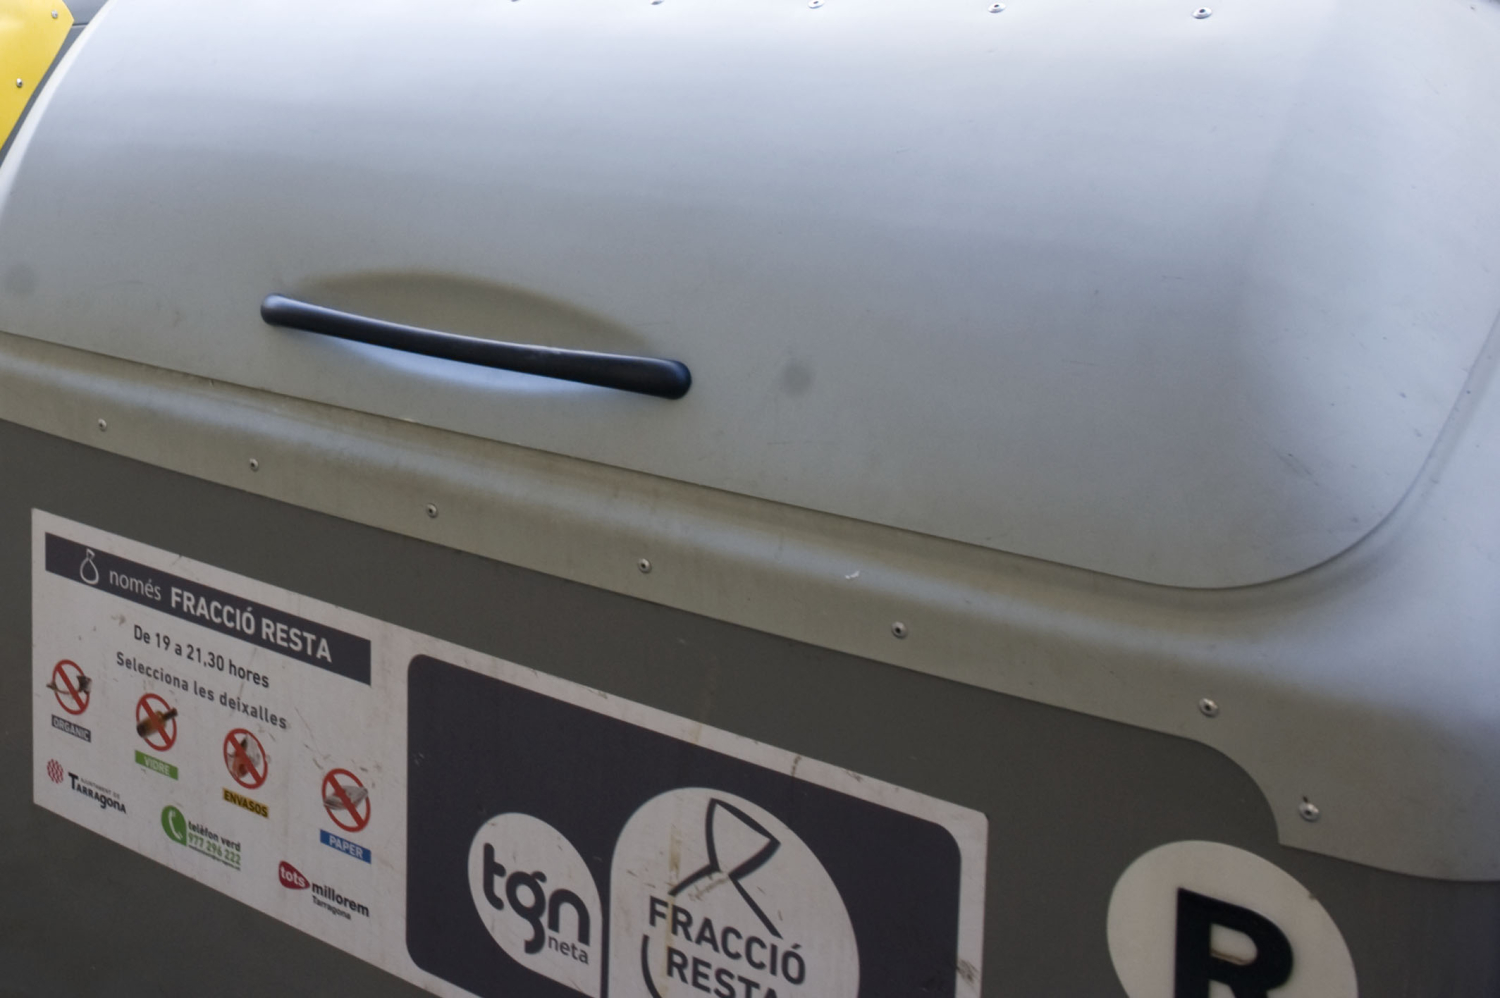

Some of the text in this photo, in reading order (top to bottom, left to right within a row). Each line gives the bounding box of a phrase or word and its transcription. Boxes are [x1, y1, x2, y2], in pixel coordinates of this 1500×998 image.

[109, 570, 333, 663] només FRACCIÓ RESTA
[133, 624, 151, 644] De
[155, 633, 171, 651] 19
[228, 660, 270, 688] hores
[116, 652, 288, 729] Selecciona les deixalles
[143, 755, 171, 776] VIDRE
[224, 790, 269, 818] ENVASOS
[188, 820, 241, 852] telèfon verd
[188, 832, 204, 848] 977
[224, 849, 241, 867] 222
[329, 835, 364, 860] PAPER
[280, 865, 307, 888] tots
[312, 882, 370, 918] millorem
[483, 842, 591, 954] tgn
[548, 935, 589, 965] neta
[649, 896, 806, 985] FRACCIÓ
[1174, 887, 1294, 998] R
